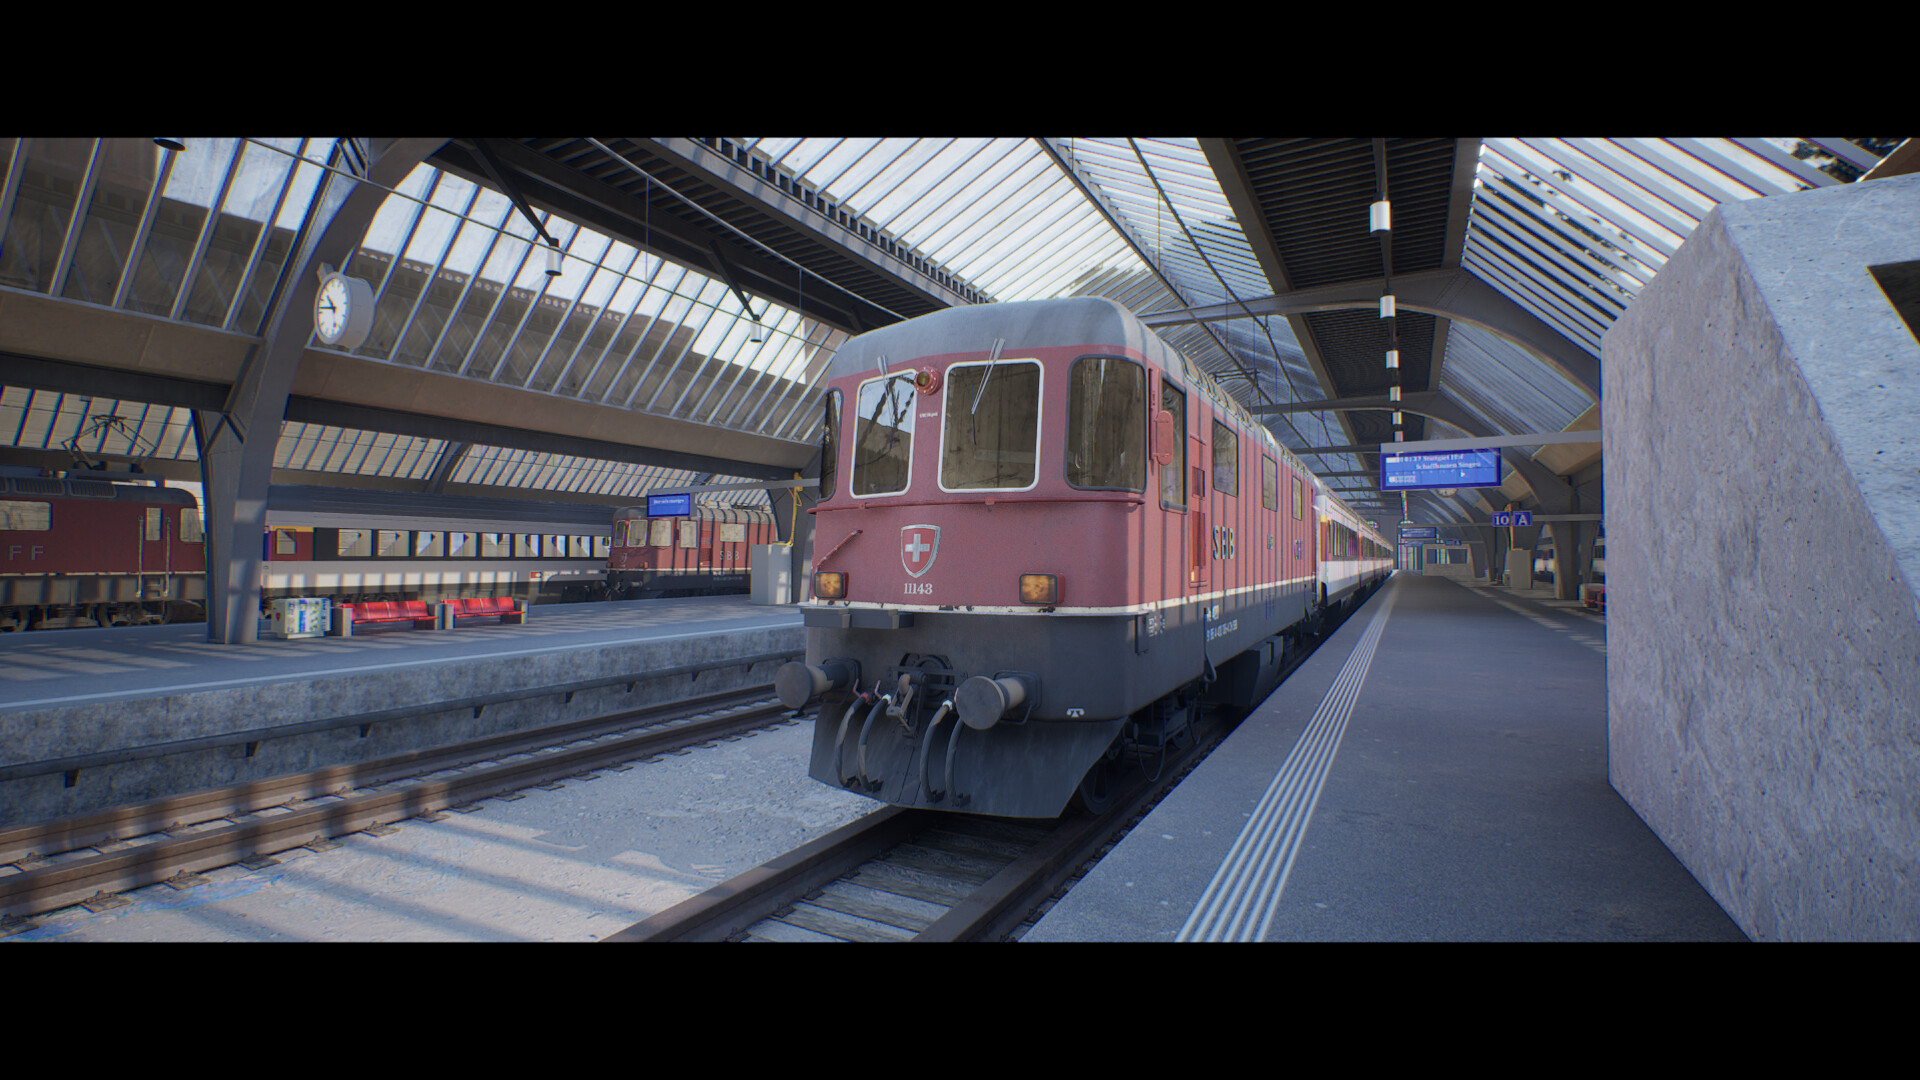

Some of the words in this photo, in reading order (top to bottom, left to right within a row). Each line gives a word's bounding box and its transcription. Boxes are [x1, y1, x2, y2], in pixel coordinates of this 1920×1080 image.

[1496, 516, 1509, 525] 10
[1518, 514, 1528, 525] A
[1213, 525, 1234, 560] SBB
[719, 550, 740, 561] SBB
[904, 583, 933, 594] 11143
